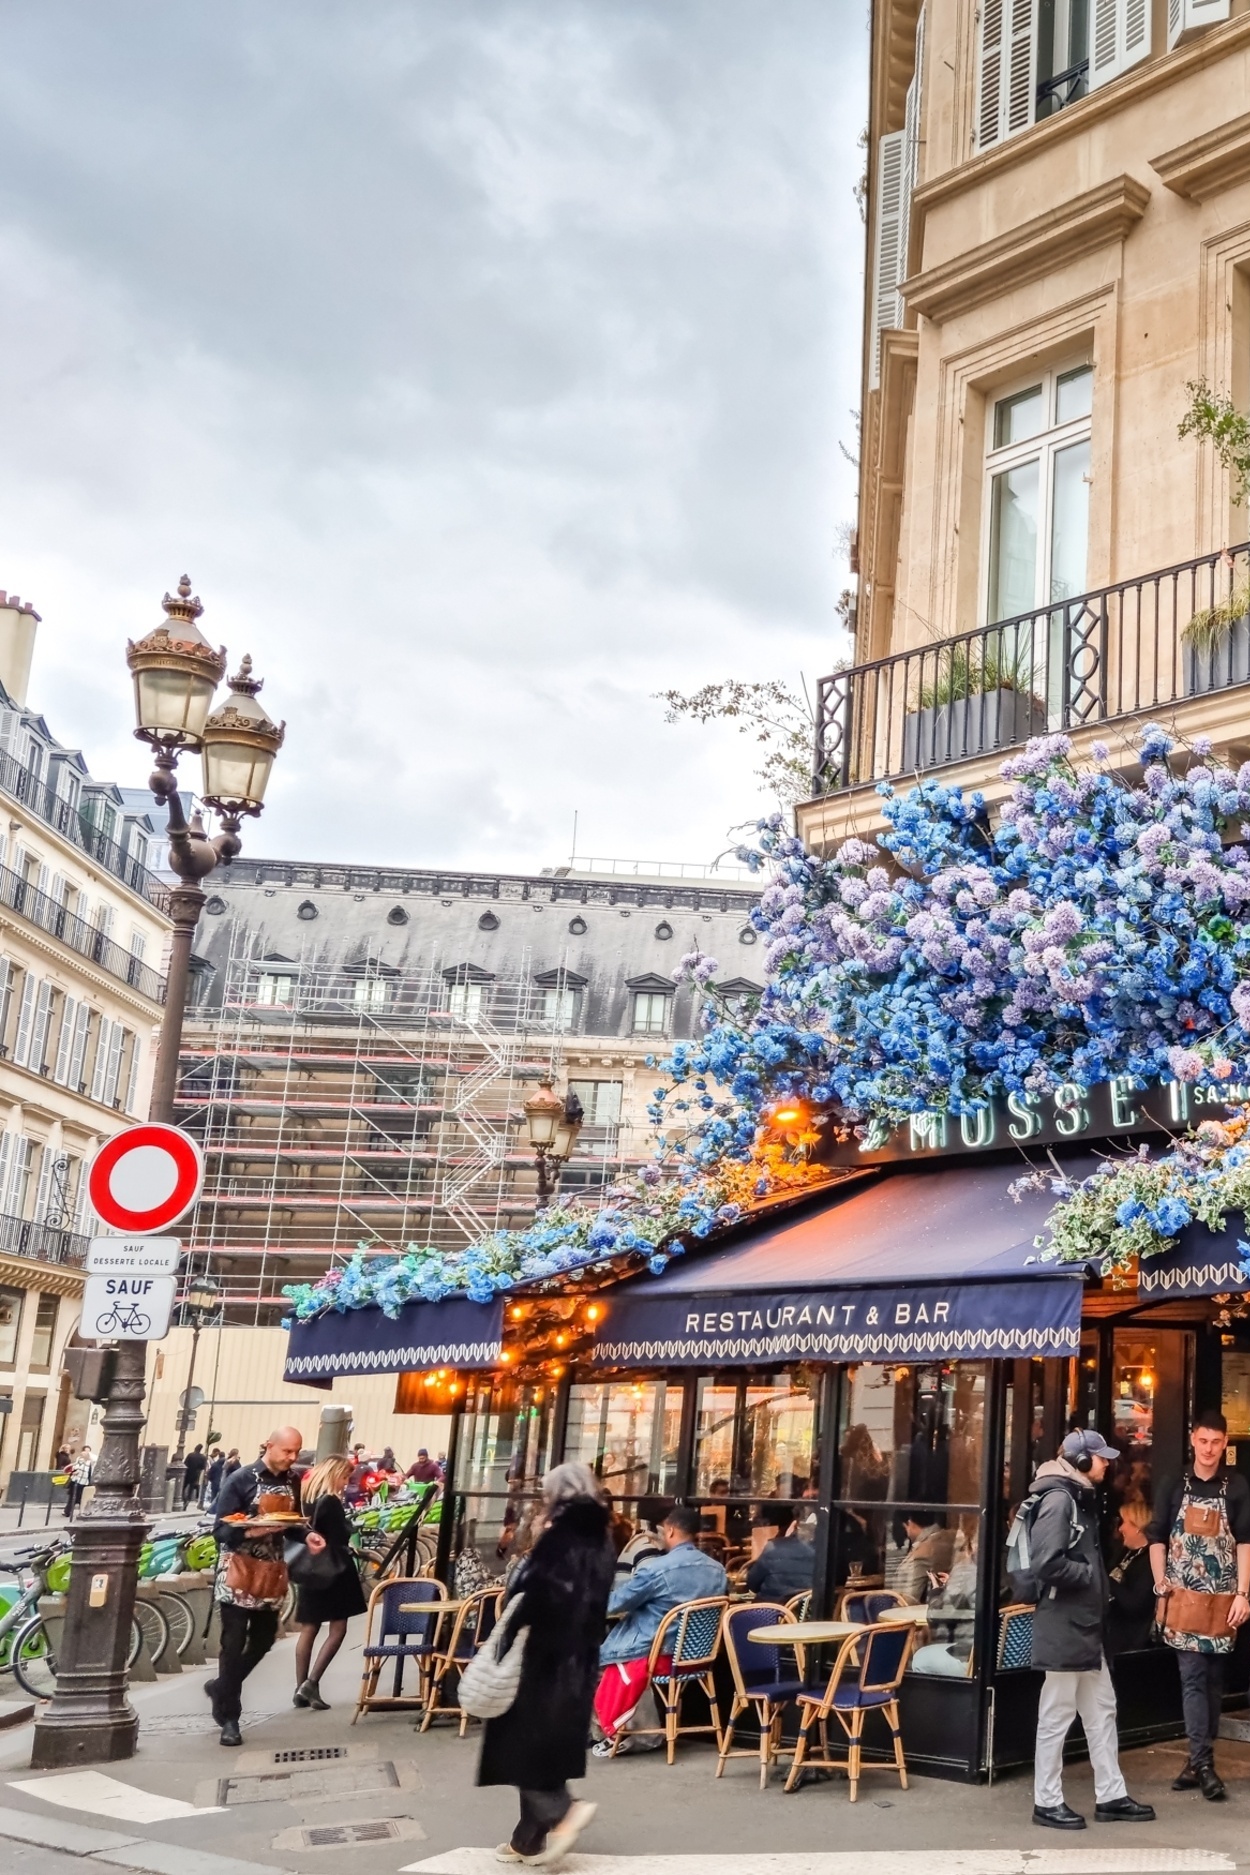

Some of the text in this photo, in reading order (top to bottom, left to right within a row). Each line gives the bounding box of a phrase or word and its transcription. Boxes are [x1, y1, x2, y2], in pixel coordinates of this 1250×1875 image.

[123, 1245, 145, 1253] SAUF
[93, 1257, 170, 1267] DESSERTE LOCALE
[105, 1279, 154, 1295] SAUF
[685, 1301, 950, 1333] RESTAURANT & BAR
